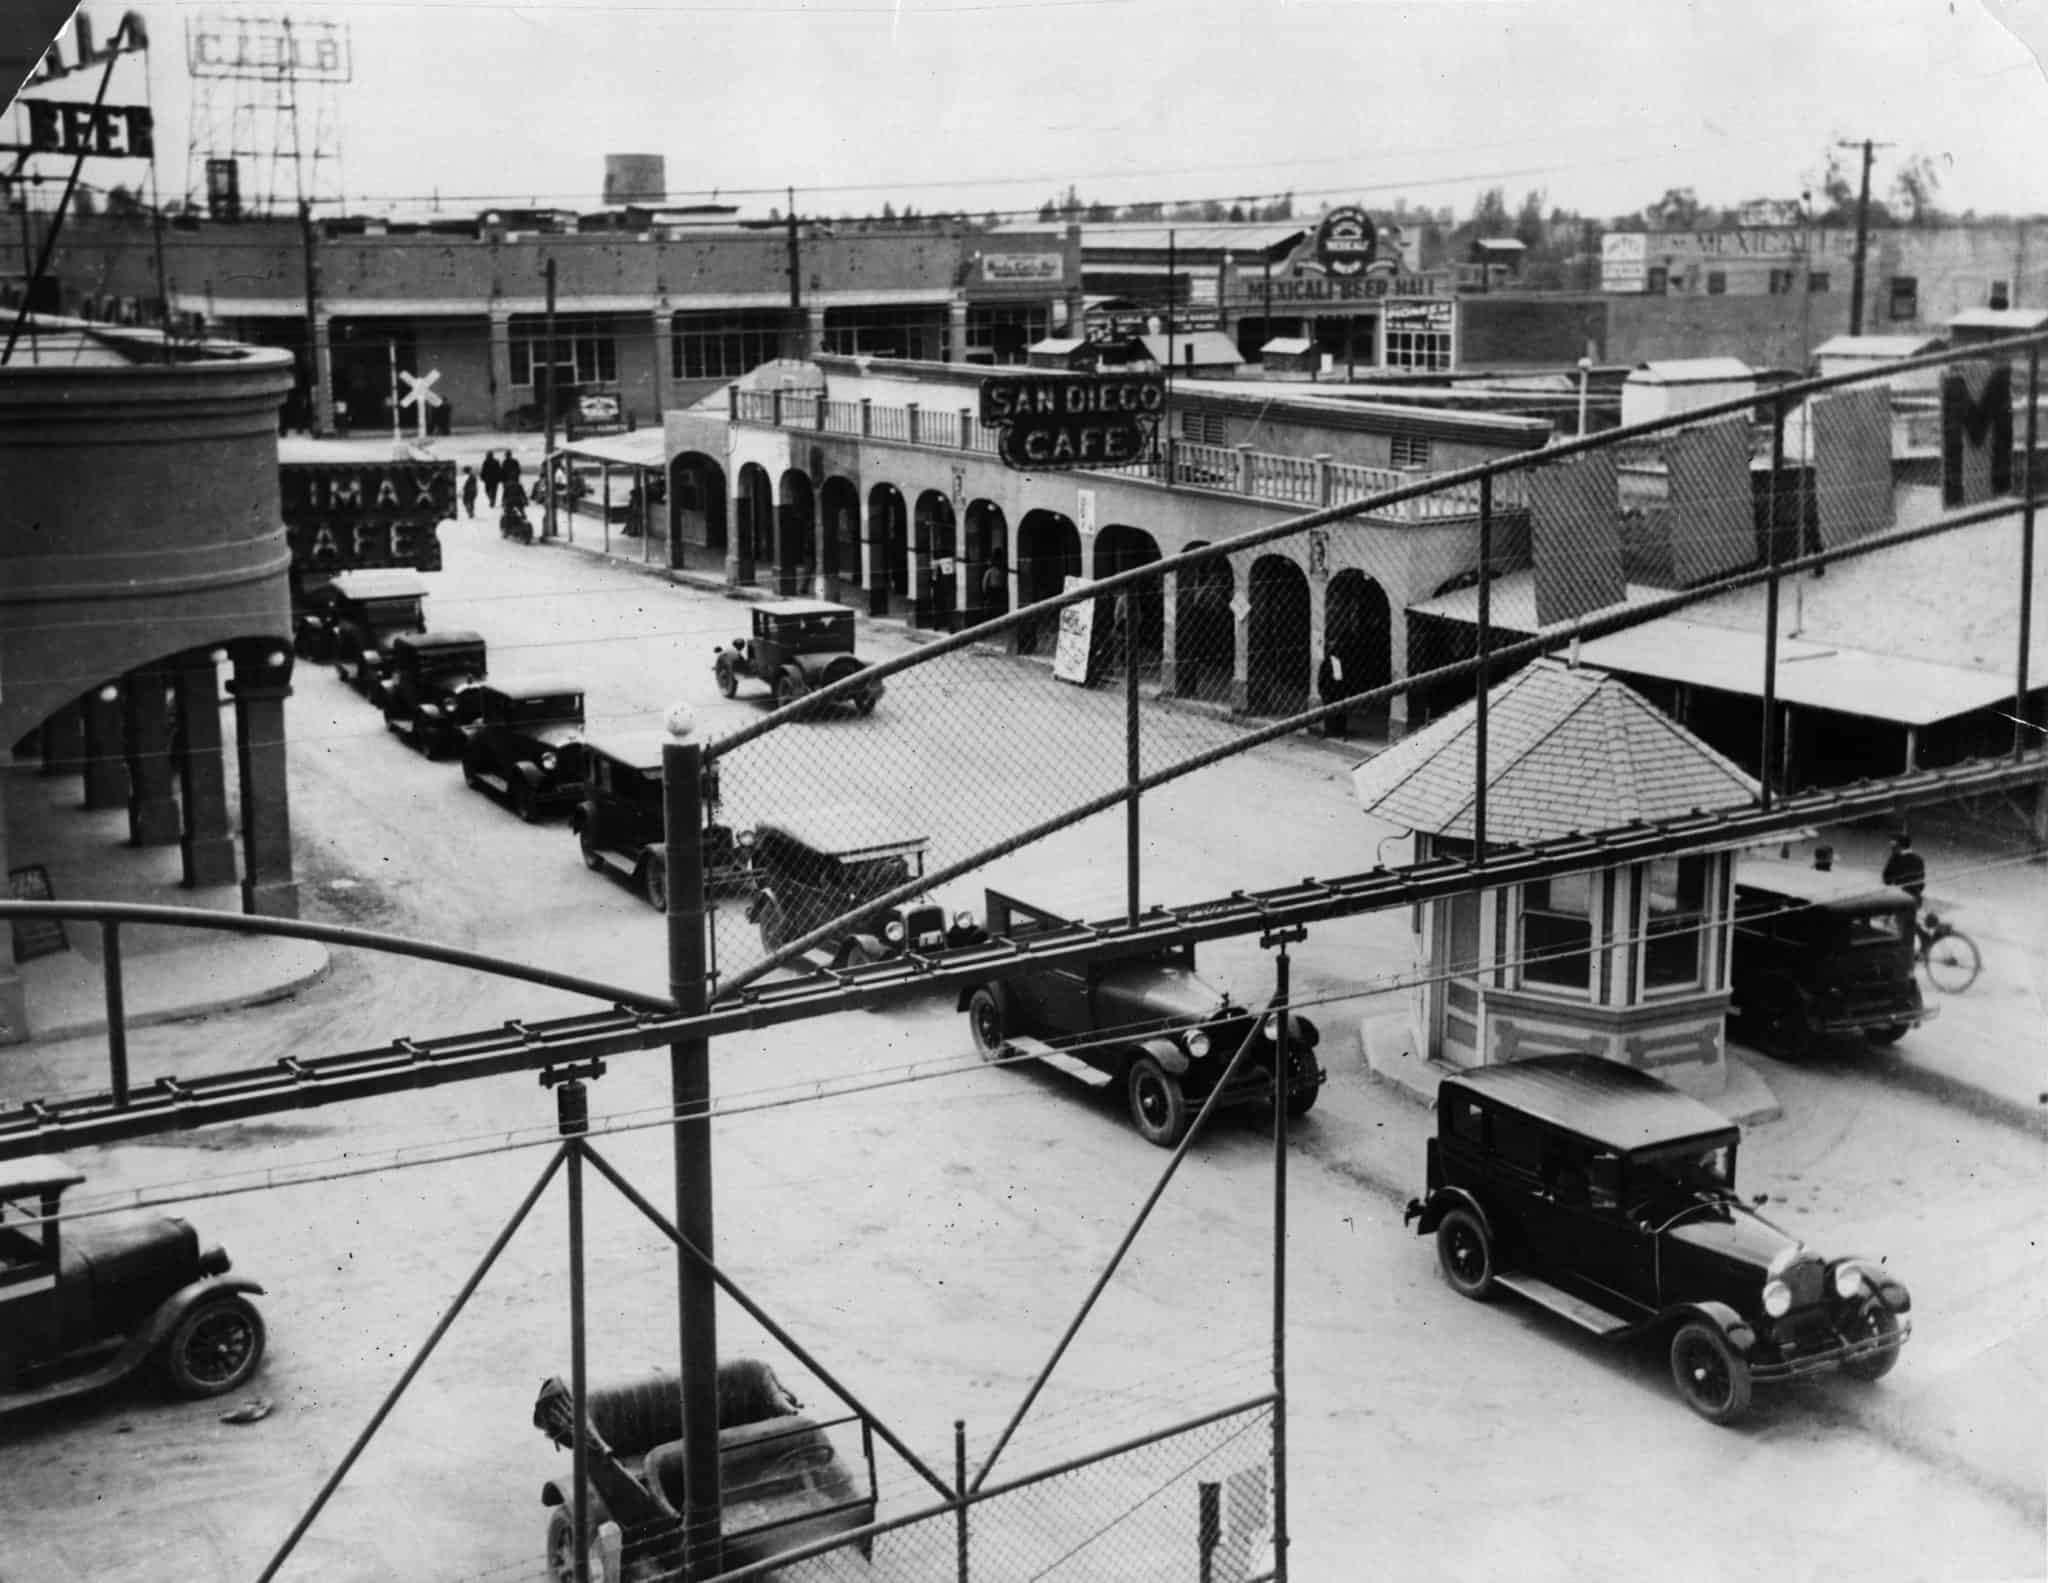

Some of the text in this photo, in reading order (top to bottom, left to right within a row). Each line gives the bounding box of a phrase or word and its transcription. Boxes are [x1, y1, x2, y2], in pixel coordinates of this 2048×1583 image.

[29, 102, 154, 157] BEER
[1249, 279, 1334, 299] MEXICALI
[1340, 280, 1388, 298] BEER
[991, 384, 1161, 414] SAN DIEGO
[1025, 428, 1130, 459] CAFE
[309, 478, 435, 508] IMAX
[311, 522, 415, 558] AFE
